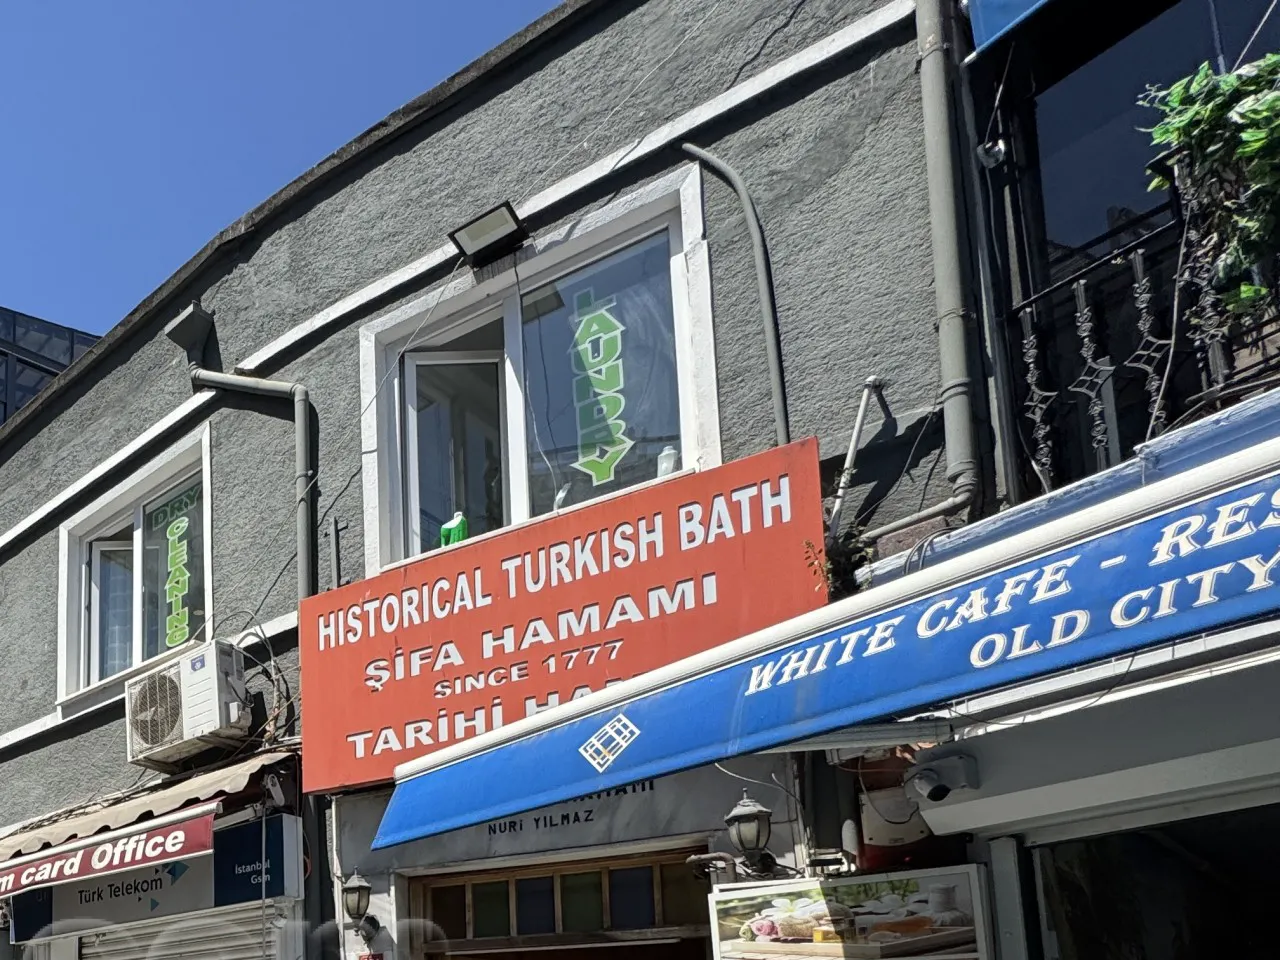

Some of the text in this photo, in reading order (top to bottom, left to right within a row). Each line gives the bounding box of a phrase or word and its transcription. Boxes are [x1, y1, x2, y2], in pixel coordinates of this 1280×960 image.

[570, 287, 635, 486] LAUNDRY
[153, 486, 201, 531] DRY
[164, 516, 190, 647] CLEANING
[318, 474, 792, 652] HISTORICAL TURKISH BATH
[970, 545, 1280, 669] OLD CITY
[364, 573, 718, 693] ŞİFA HAMAMI
[434, 640, 624, 699] SINCE 1777
[744, 615, 906, 697] WHITE
[916, 554, 1081, 639] CAFE
[347, 696, 504, 759] TARİHİ
[20, 849, 84, 887] card
[91, 829, 186, 870] Office
[533, 809, 594, 830] YILMAZ
[78, 873, 163, 905] Türk Telekom
